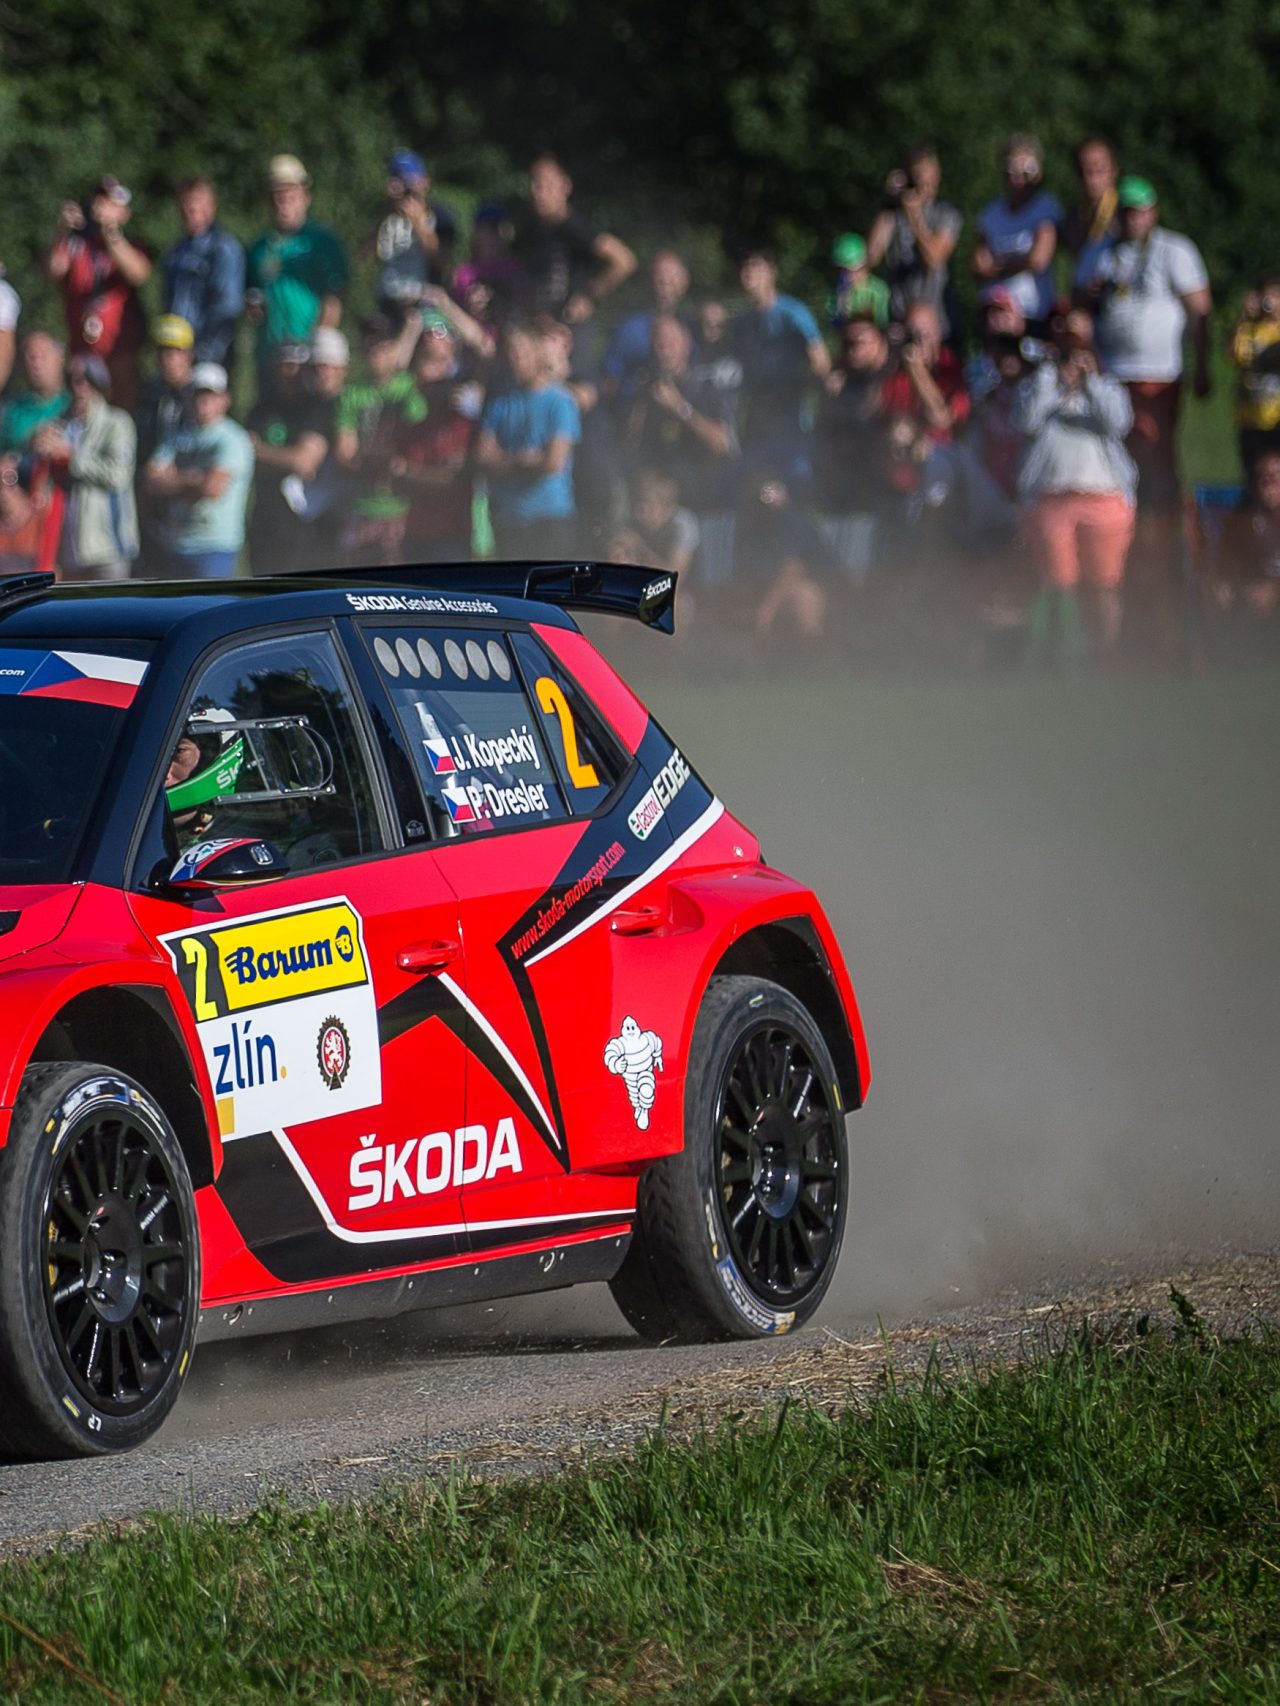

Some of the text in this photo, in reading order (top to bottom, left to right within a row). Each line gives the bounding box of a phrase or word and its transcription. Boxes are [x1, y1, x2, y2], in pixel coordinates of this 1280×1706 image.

[346, 593, 499, 613] ŠKODA Genuine Accessories
[451, 725, 542, 775] J. Kopecký
[535, 677, 600, 790] 2
[466, 778, 549, 820] P. Dresler
[652, 748, 691, 810] EDGE
[635, 798, 662, 832] Castrol
[510, 840, 626, 960] www.skoda-motorsport.com
[180, 937, 334, 1022] 2 Barum
[348, 1116, 523, 1212] ŠKODA
